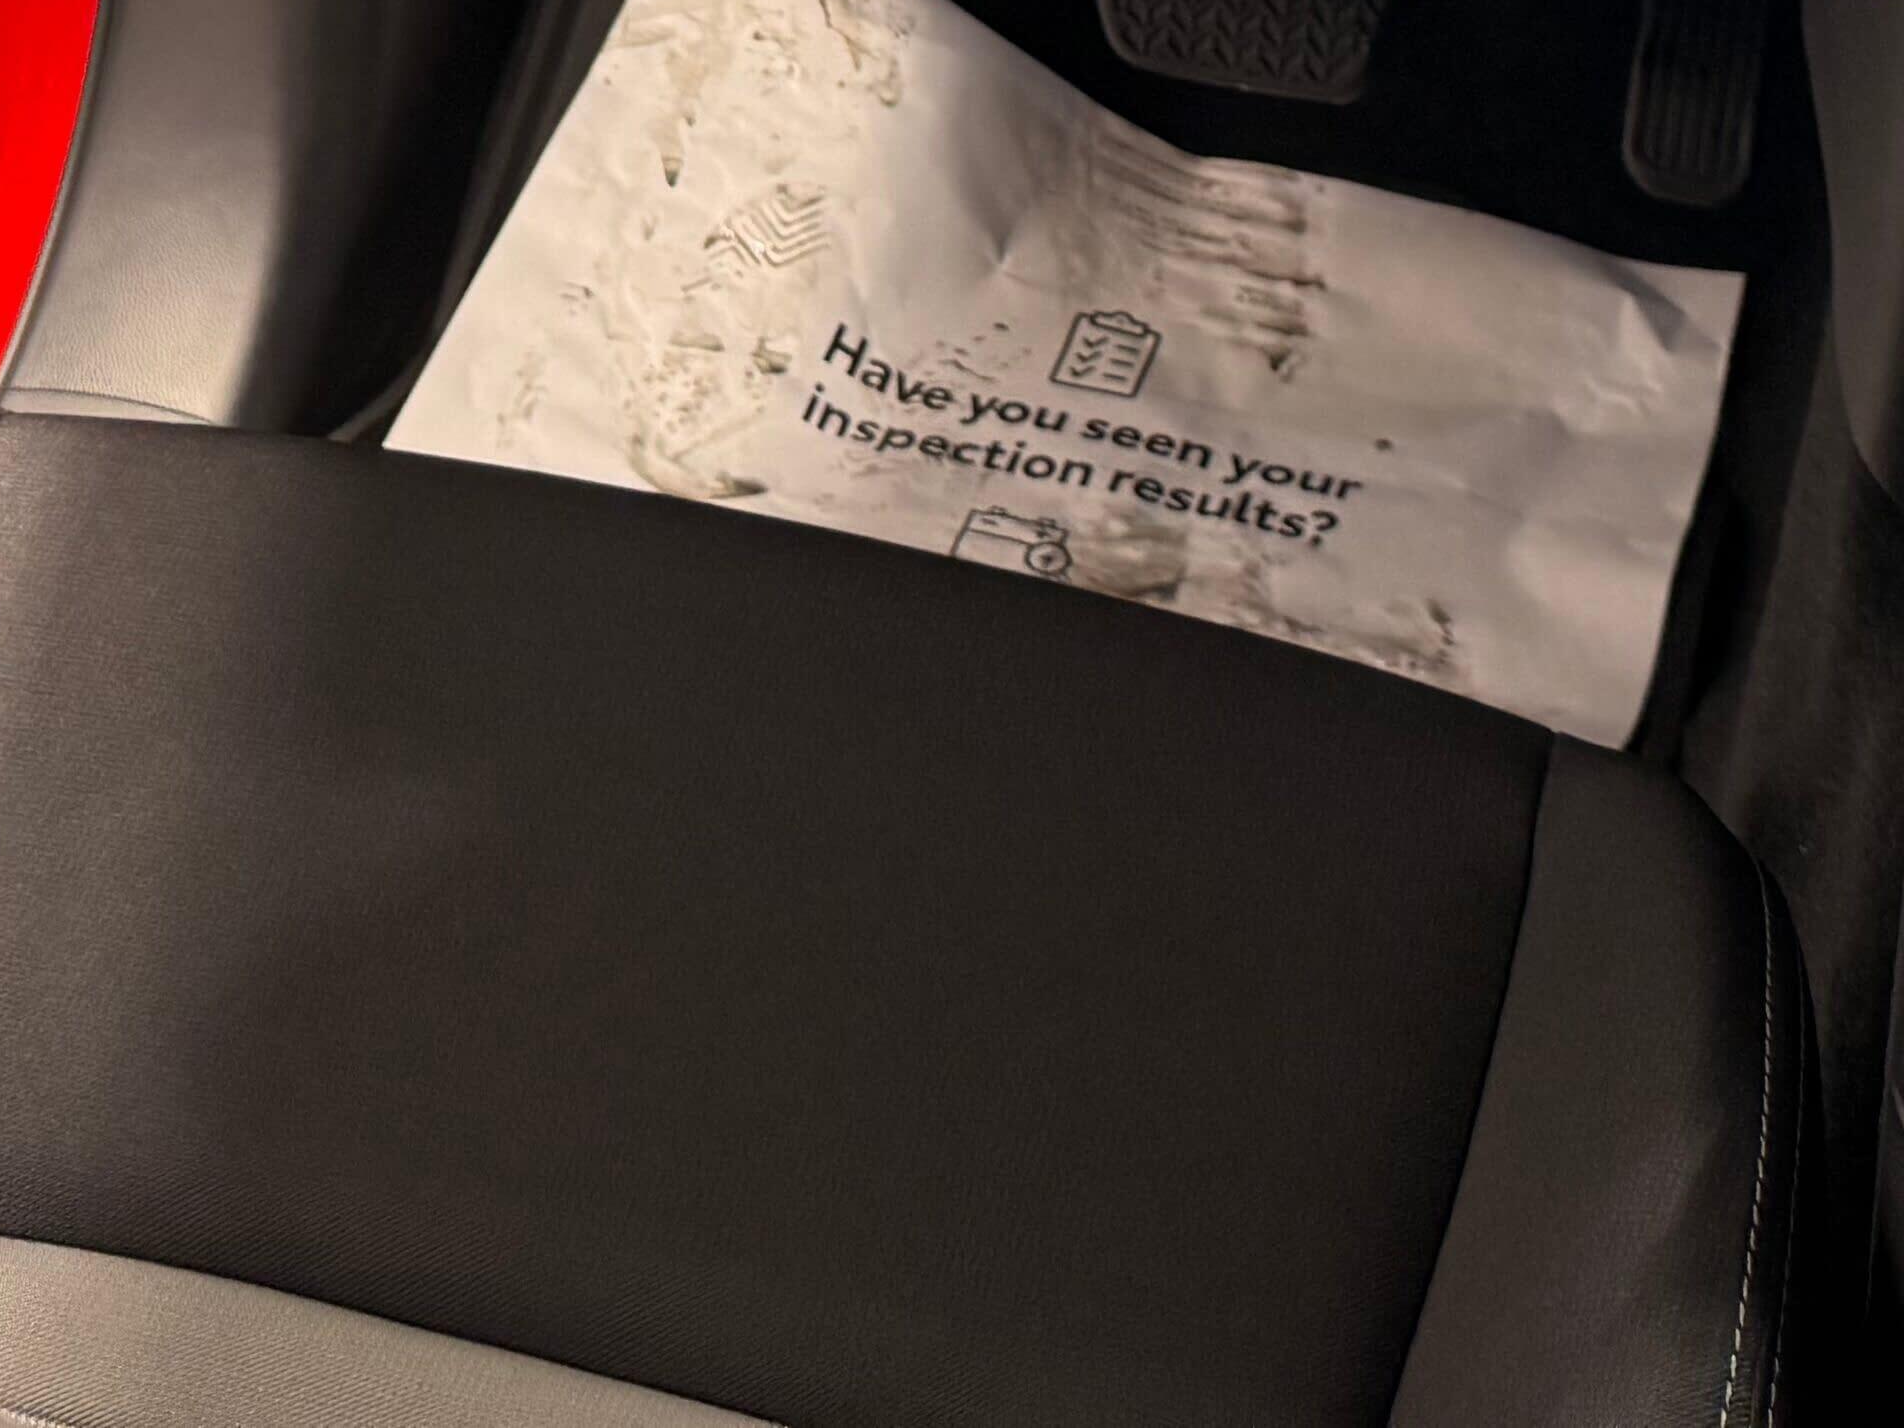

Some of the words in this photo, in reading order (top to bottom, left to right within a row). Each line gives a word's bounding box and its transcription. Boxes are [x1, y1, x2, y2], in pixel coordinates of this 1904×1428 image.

[802, 385, 1094, 488] inspection
[1109, 465, 1341, 547] results?
[822, 322, 951, 411] Have
[957, 390, 1068, 434] you
[1081, 418, 1210, 470] seen
[1223, 451, 1364, 503] your
